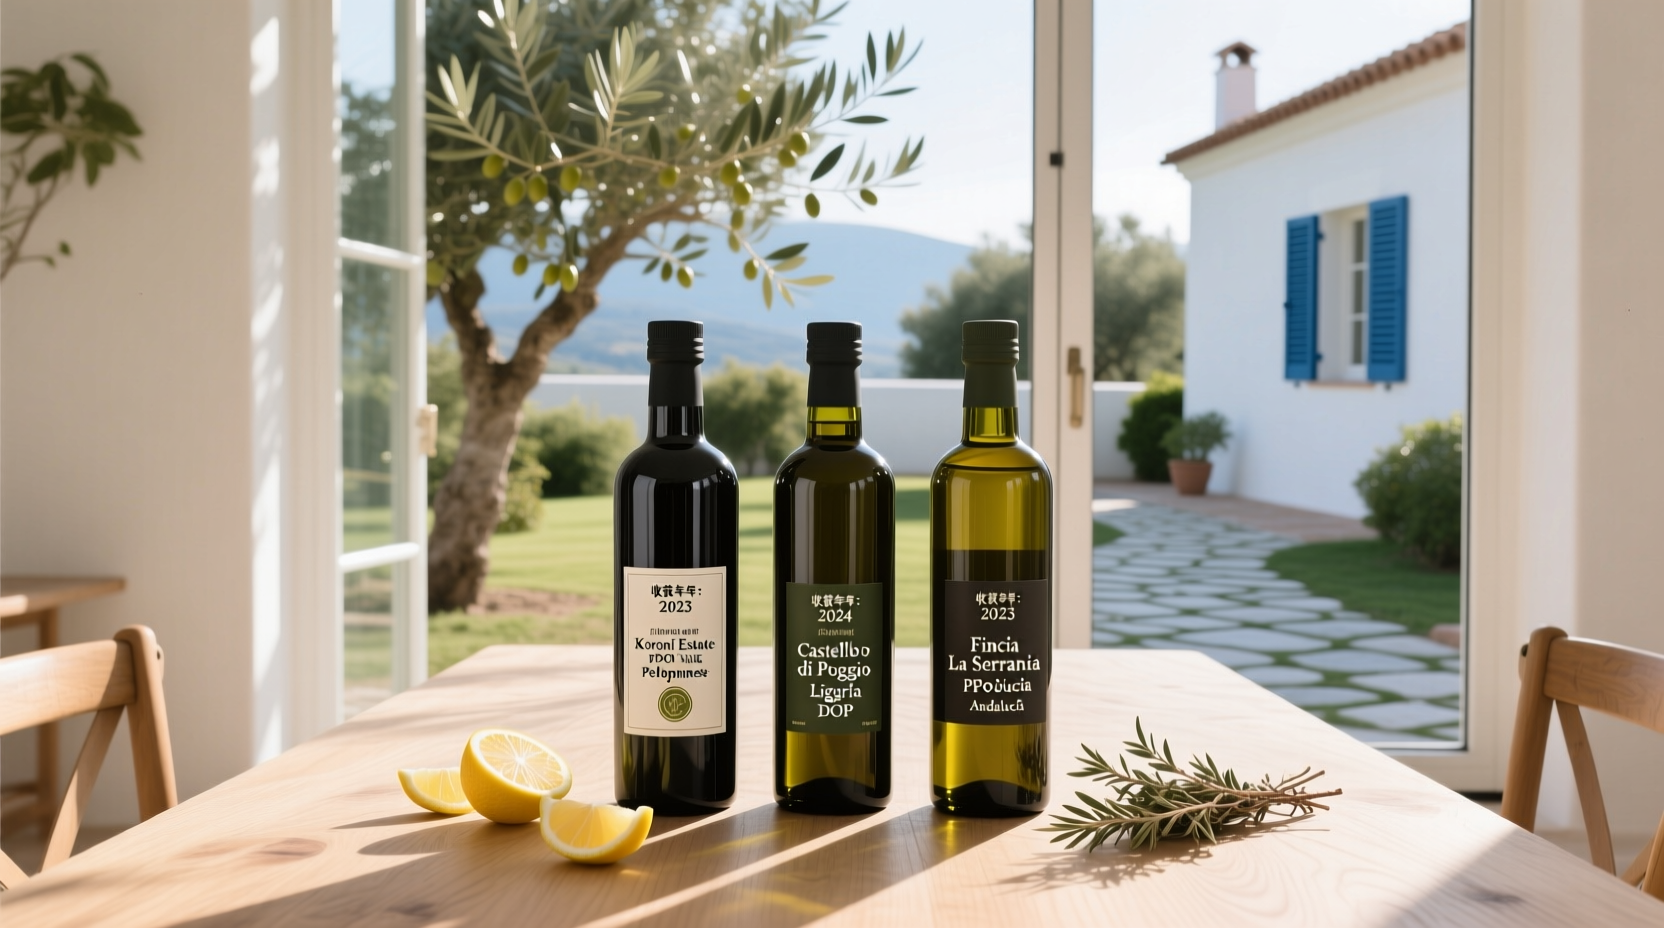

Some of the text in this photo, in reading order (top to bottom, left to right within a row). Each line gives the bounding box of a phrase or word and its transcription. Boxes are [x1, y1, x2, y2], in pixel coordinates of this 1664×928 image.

[659, 600, 692, 613] 2023
[817, 609, 852, 623] 2024
[981, 607, 1016, 621] 2023
[970, 636, 1019, 653] Fincia
[948, 654, 1040, 671] La Serrania
[797, 660, 871, 682] di Poggio
[817, 704, 854, 718] DOP
